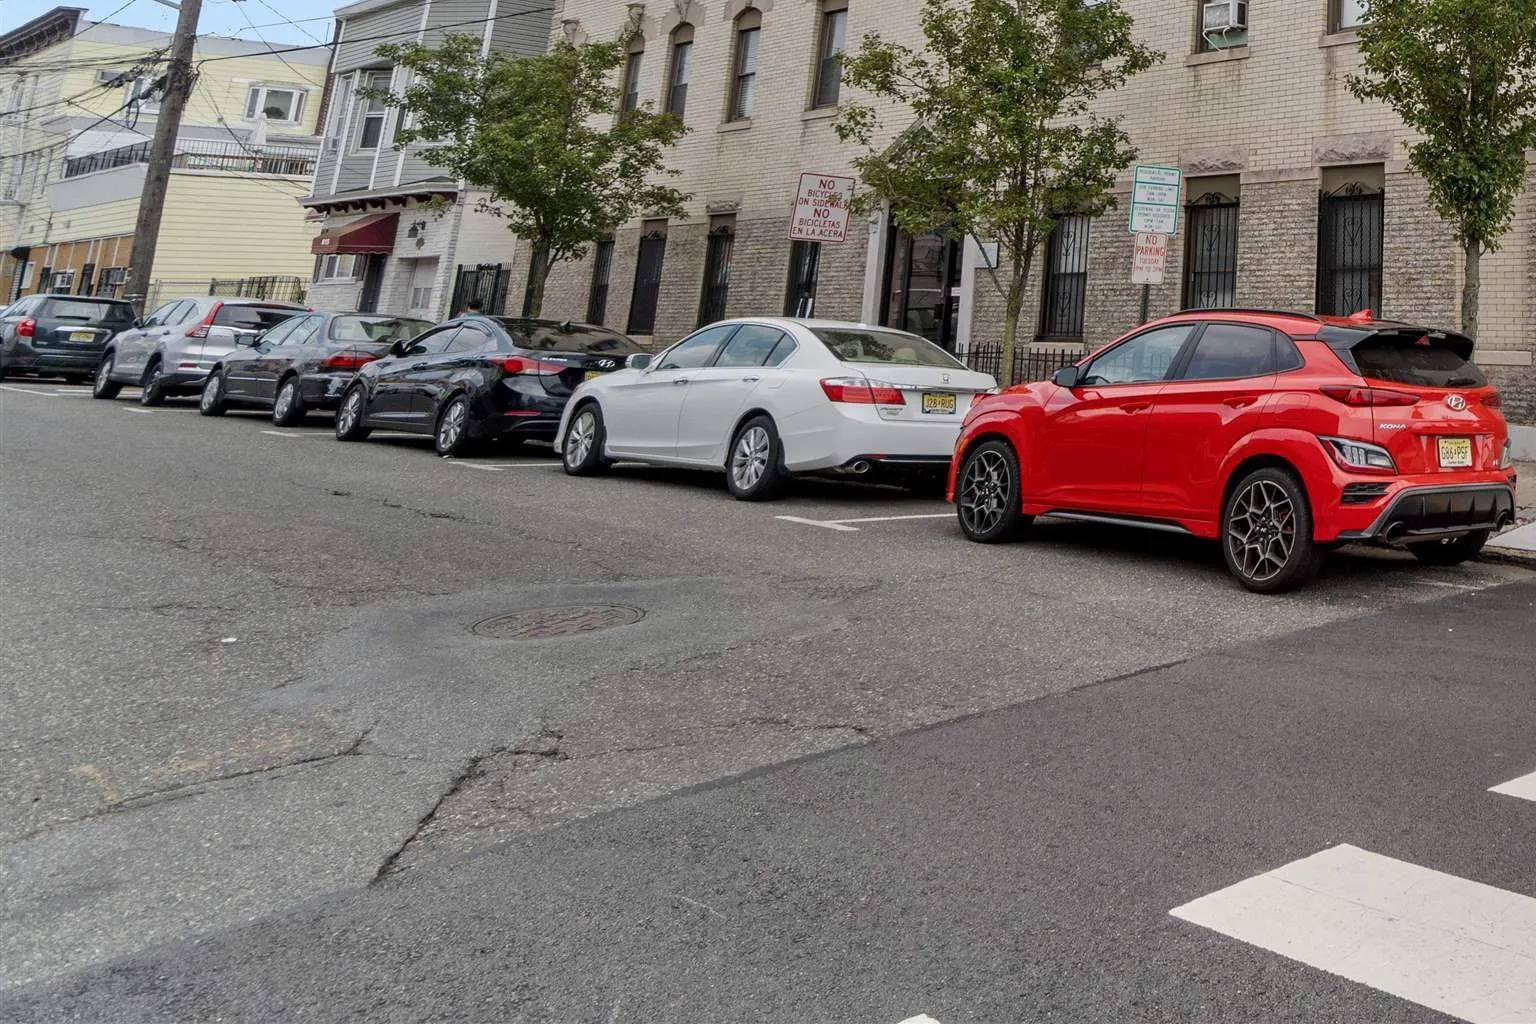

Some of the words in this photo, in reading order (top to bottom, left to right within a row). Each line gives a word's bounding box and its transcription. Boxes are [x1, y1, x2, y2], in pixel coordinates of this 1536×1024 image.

[819, 179, 835, 190] NO
[808, 189, 842, 200] BICYCLES
[798, 197, 810, 206] ON
[813, 208, 830, 219] NO
[799, 218, 840, 229] BICICLETAS
[792, 227, 803, 235] EN
[806, 228, 816, 236] LA
[818, 228, 843, 238] ACERA
[1146, 235, 1158, 245] NO
[1136, 246, 1165, 256] PARKING
[1379, 423, 1407, 431] KONA
